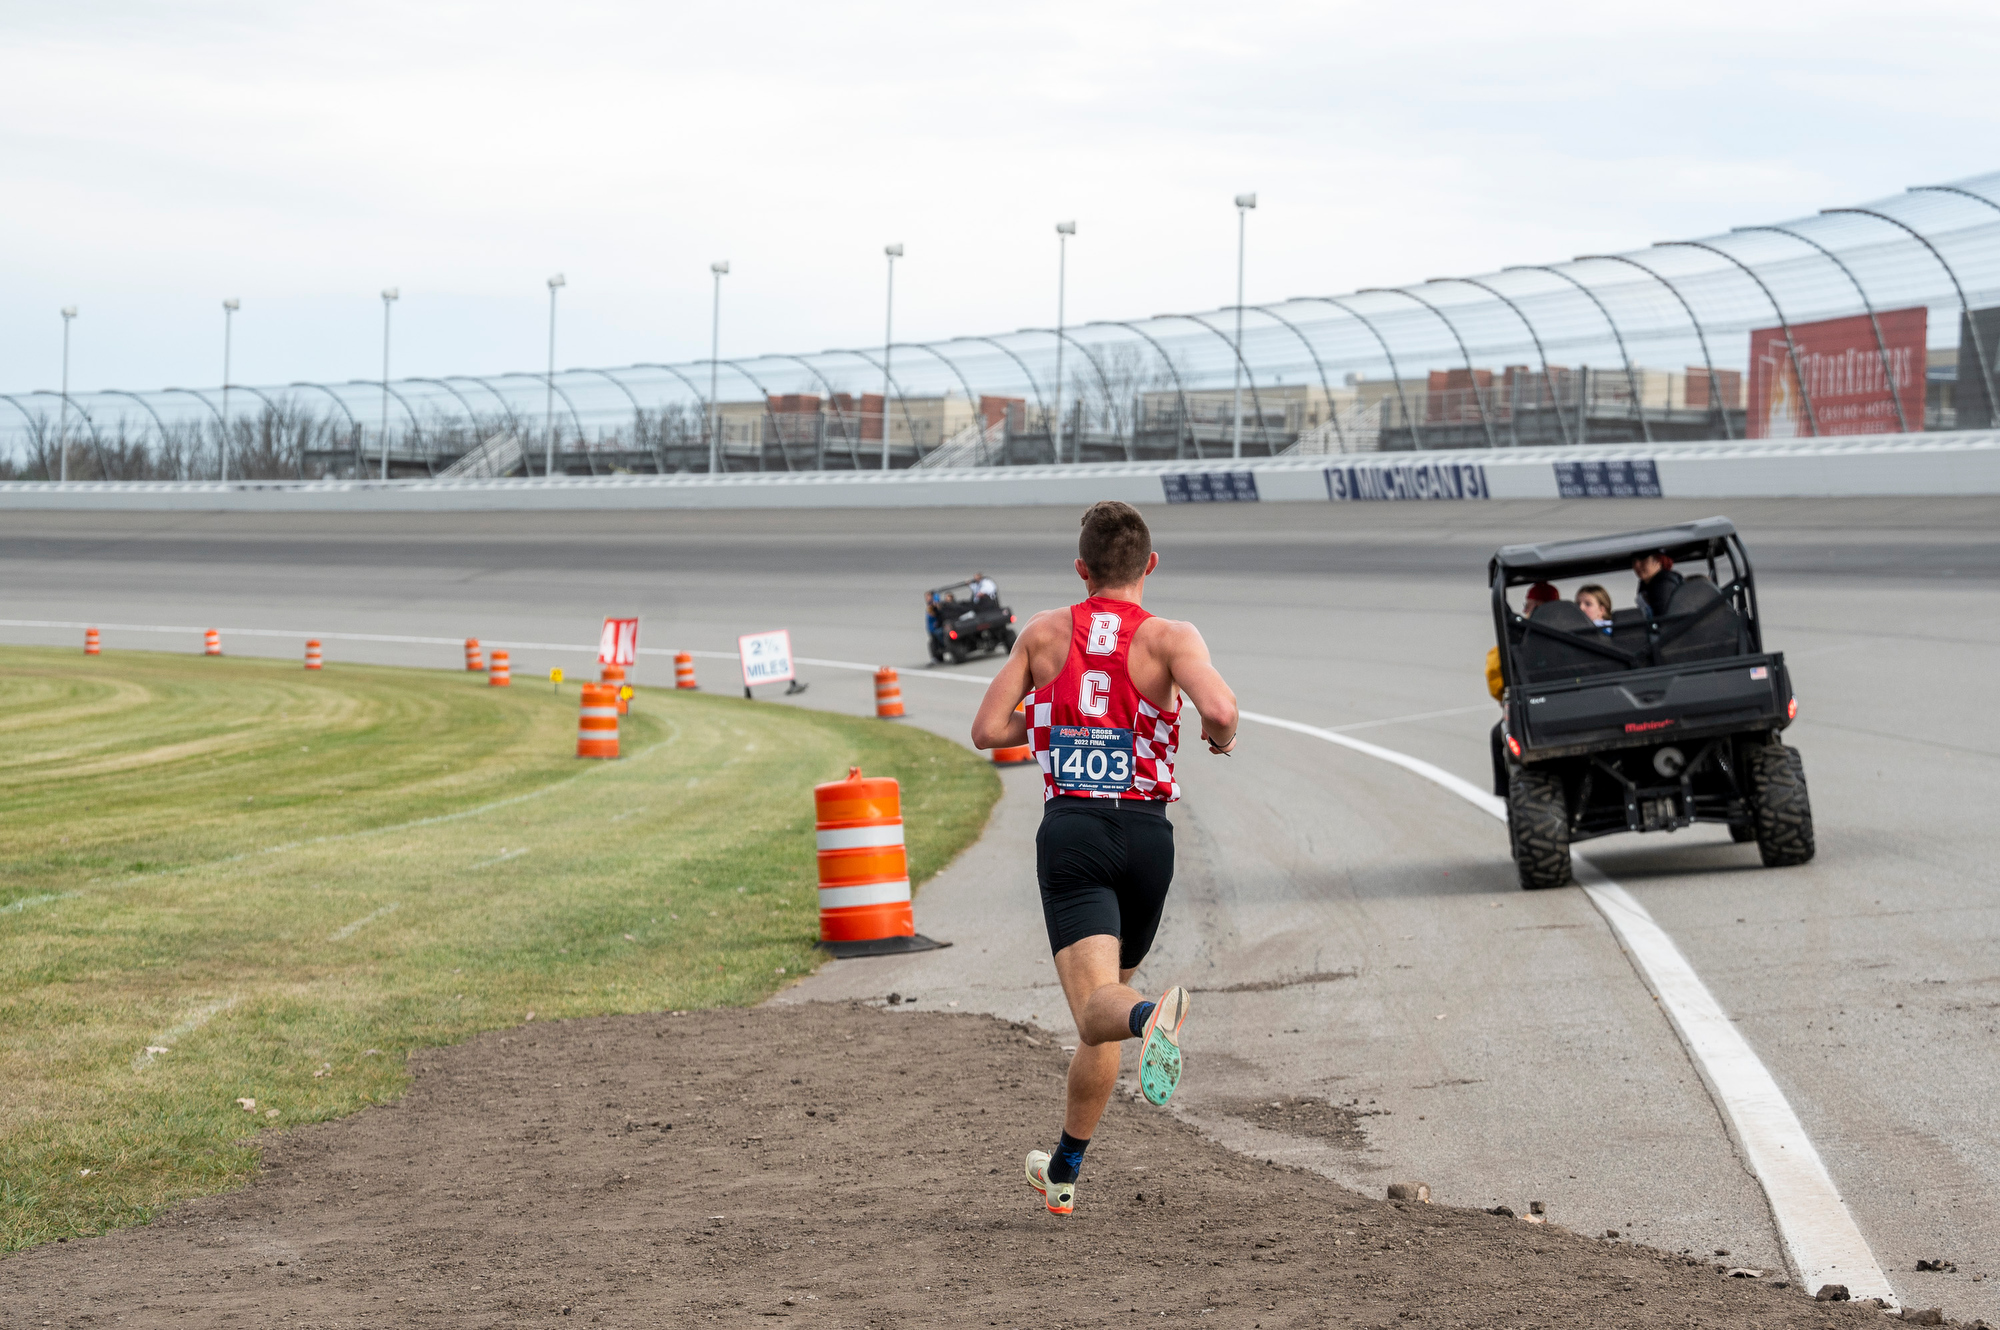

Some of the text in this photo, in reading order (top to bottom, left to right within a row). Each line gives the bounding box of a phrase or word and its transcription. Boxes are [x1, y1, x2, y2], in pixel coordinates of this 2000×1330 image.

[1354, 465, 1457, 499] MICHIGAN
[600, 621, 636, 664] 4K
[1086, 612, 1122, 656] B
[747, 658, 788, 677] MILES
[1078, 670, 1111, 717] C
[1051, 748, 1129, 781] 1403
